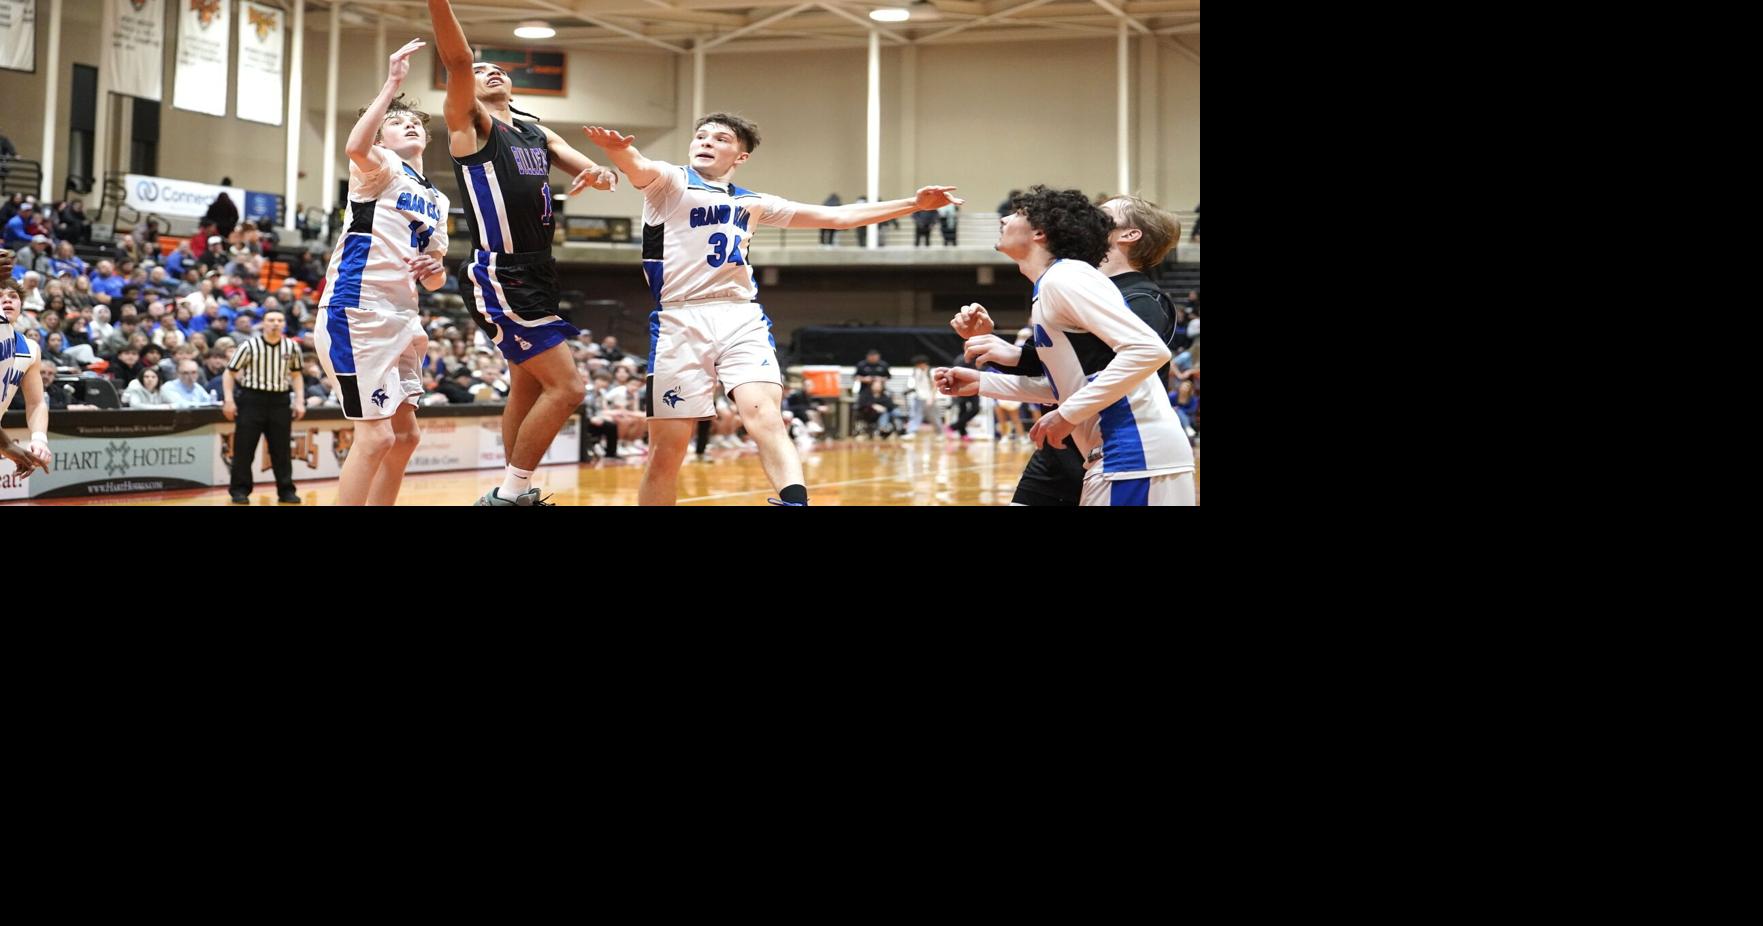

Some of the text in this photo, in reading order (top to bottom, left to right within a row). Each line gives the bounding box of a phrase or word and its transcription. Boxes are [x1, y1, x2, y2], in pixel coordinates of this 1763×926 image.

[690, 204, 731, 228] GRAND
[707, 232, 745, 268] 34
[54, 447, 196, 471] HART HOTELS
